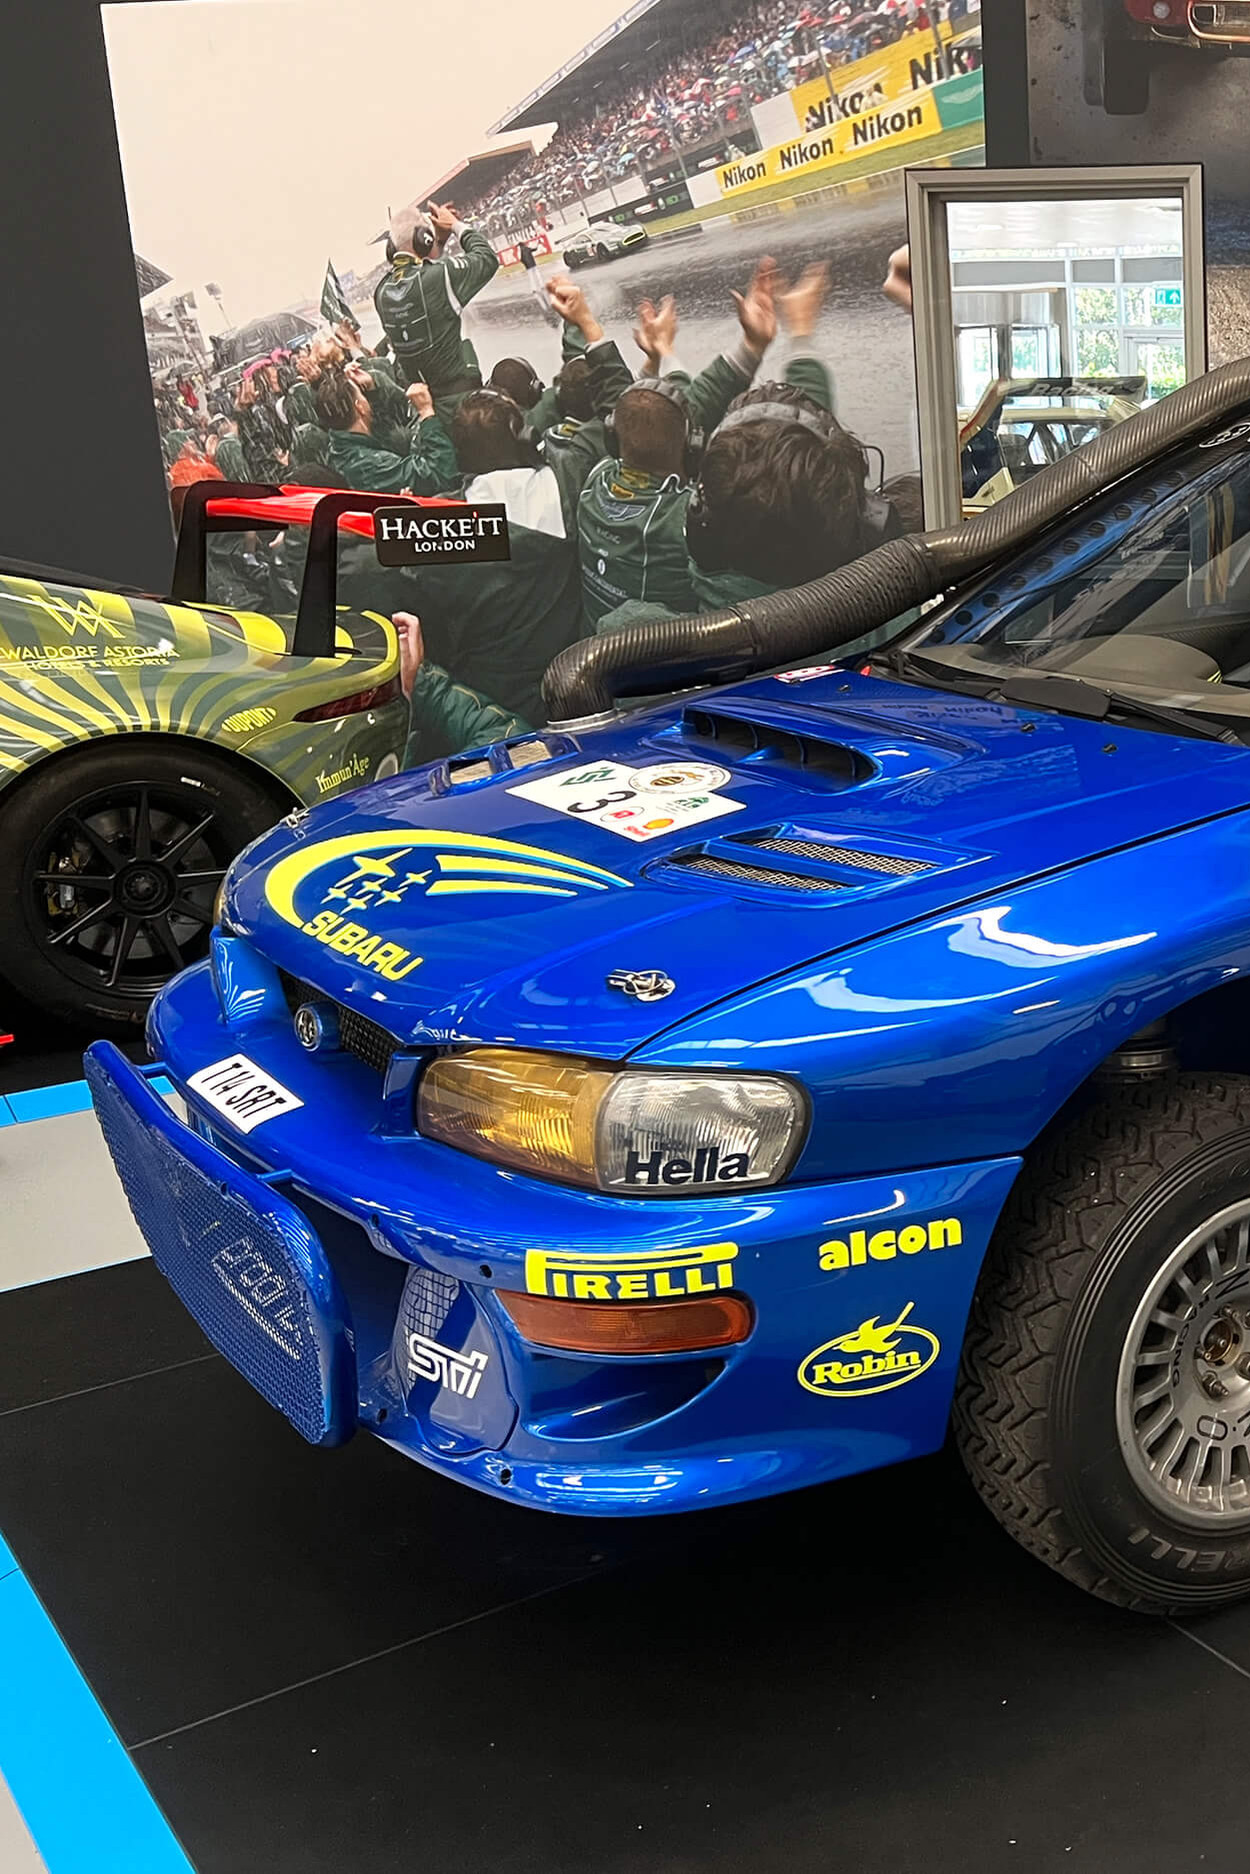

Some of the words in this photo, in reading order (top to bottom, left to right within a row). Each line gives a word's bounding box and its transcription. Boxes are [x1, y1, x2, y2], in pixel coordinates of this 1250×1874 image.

[908, 37, 969, 91] Nik
[723, 160, 766, 188] Nikon
[779, 137, 834, 170] Nikon
[852, 105, 922, 146] Nikon
[380, 511, 503, 540] HACKETT
[414, 540, 476, 553] LONDON
[302, 910, 424, 981] SUBARU
[225, 1085, 287, 1119] SRT
[625, 1147, 750, 1185] Hella
[819, 1217, 962, 1271] alcon
[525, 1241, 739, 1299] PIRELLI
[812, 1350, 921, 1385] Robin
